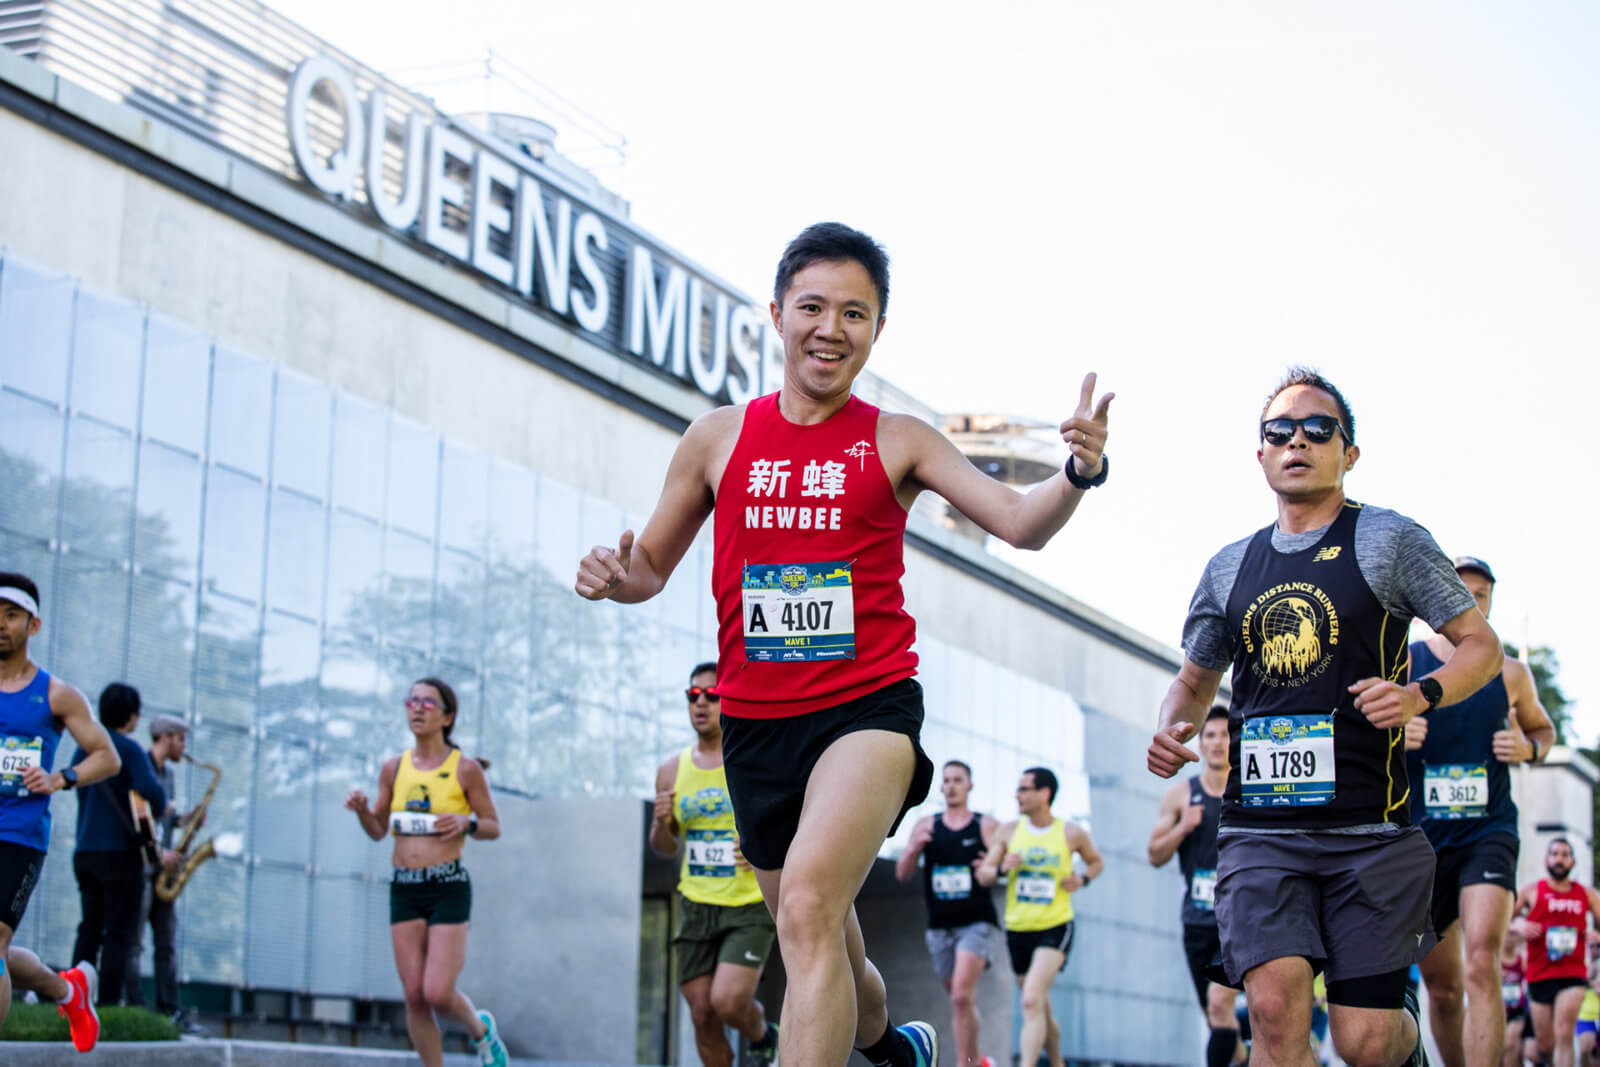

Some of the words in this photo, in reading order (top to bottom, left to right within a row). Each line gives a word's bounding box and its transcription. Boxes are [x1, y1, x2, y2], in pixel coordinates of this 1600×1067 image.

[288, 55, 609, 333] QUEENS
[628, 244, 784, 405] MUSE
[747, 459, 847, 499] 新蜂
[745, 506, 842, 530] NEWBEE
[749, 603, 768, 632] A
[781, 600, 833, 631] 4107
[1242, 603, 1258, 653] QUEENS
[1256, 582, 1315, 604] DISTANCE
[1314, 587, 1340, 646] RUNNERS
[785, 638, 805, 646] WAVE
[1287, 675, 1310, 688] NEW
[1310, 652, 1334, 677] YORK
[1246, 753, 1261, 780] A
[1270, 750, 1317, 778] 1789
[1429, 787, 1440, 802] A
[1448, 785, 1478, 802] 3612
